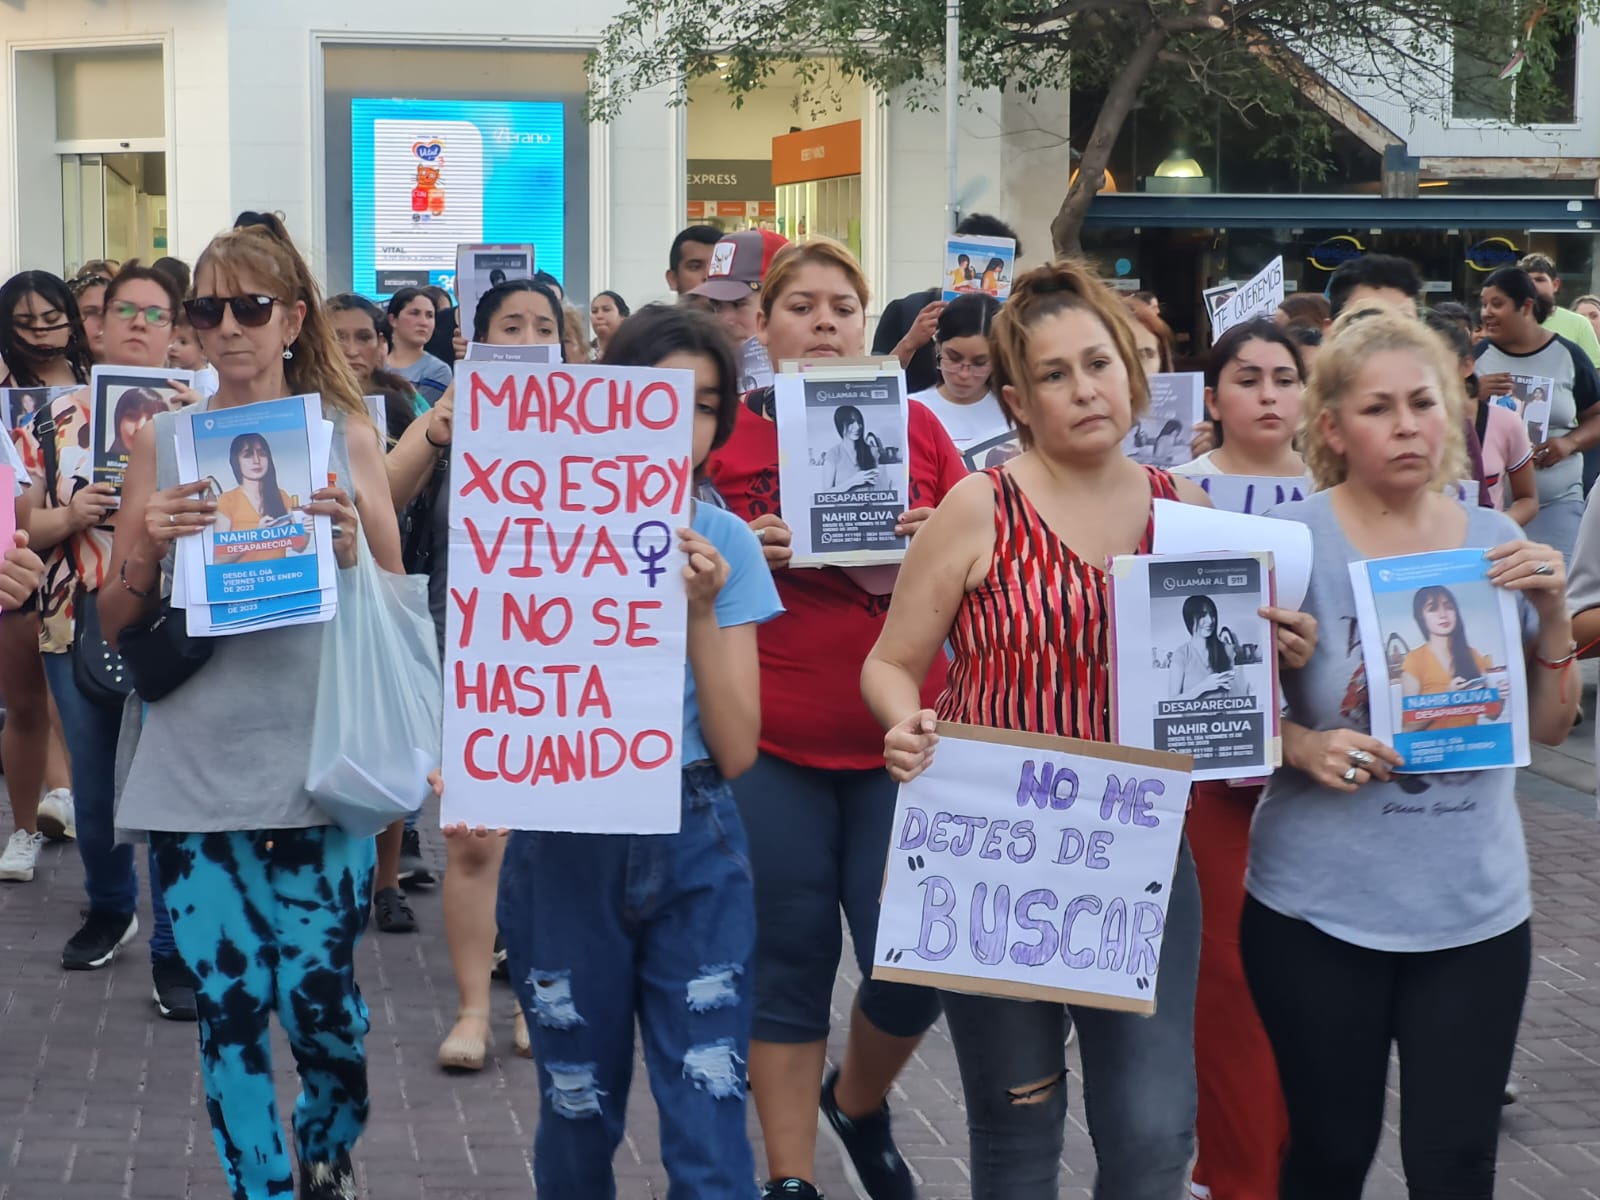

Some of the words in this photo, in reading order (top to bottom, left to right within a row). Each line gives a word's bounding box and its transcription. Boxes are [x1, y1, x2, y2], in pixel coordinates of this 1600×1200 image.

[687, 174, 737, 185] EXPRESS
[1214, 306, 1229, 334] TE
[1234, 264, 1281, 320] QUEREMOS
[470, 371, 680, 435] MARCHO
[460, 452, 547, 511] XQ
[559, 455, 691, 515] ESTOY
[817, 492, 895, 503] DESAPARECIDA
[822, 512, 857, 522] NAHIR
[860, 511, 895, 521] OLIVA
[219, 531, 258, 544] NAHIR
[261, 525, 298, 539] OLIVA
[227, 539, 293, 553] DESAPARECIDA
[463, 516, 629, 578] VIVA
[1176, 578, 1212, 587] LLAMAR
[1213, 577, 1225, 585] AL
[450, 587, 478, 648] Y
[502, 592, 573, 646] NO
[592, 597, 663, 647] SE
[455, 660, 612, 719] HASTA
[1162, 698, 1253, 713] DESAPARECIDA
[1408, 694, 1450, 709] NAHIR
[1452, 690, 1493, 704] OLIVA
[1415, 705, 1486, 720] DESAPARECIDA
[1167, 722, 1208, 736] NAHIR
[1211, 720, 1252, 732] OLIVA
[464, 727, 673, 786] CUANDO
[1016, 760, 1080, 810] NO
[1099, 774, 1165, 828] ME
[896, 807, 1036, 864] DEJES
[1052, 827, 1114, 870] DE
